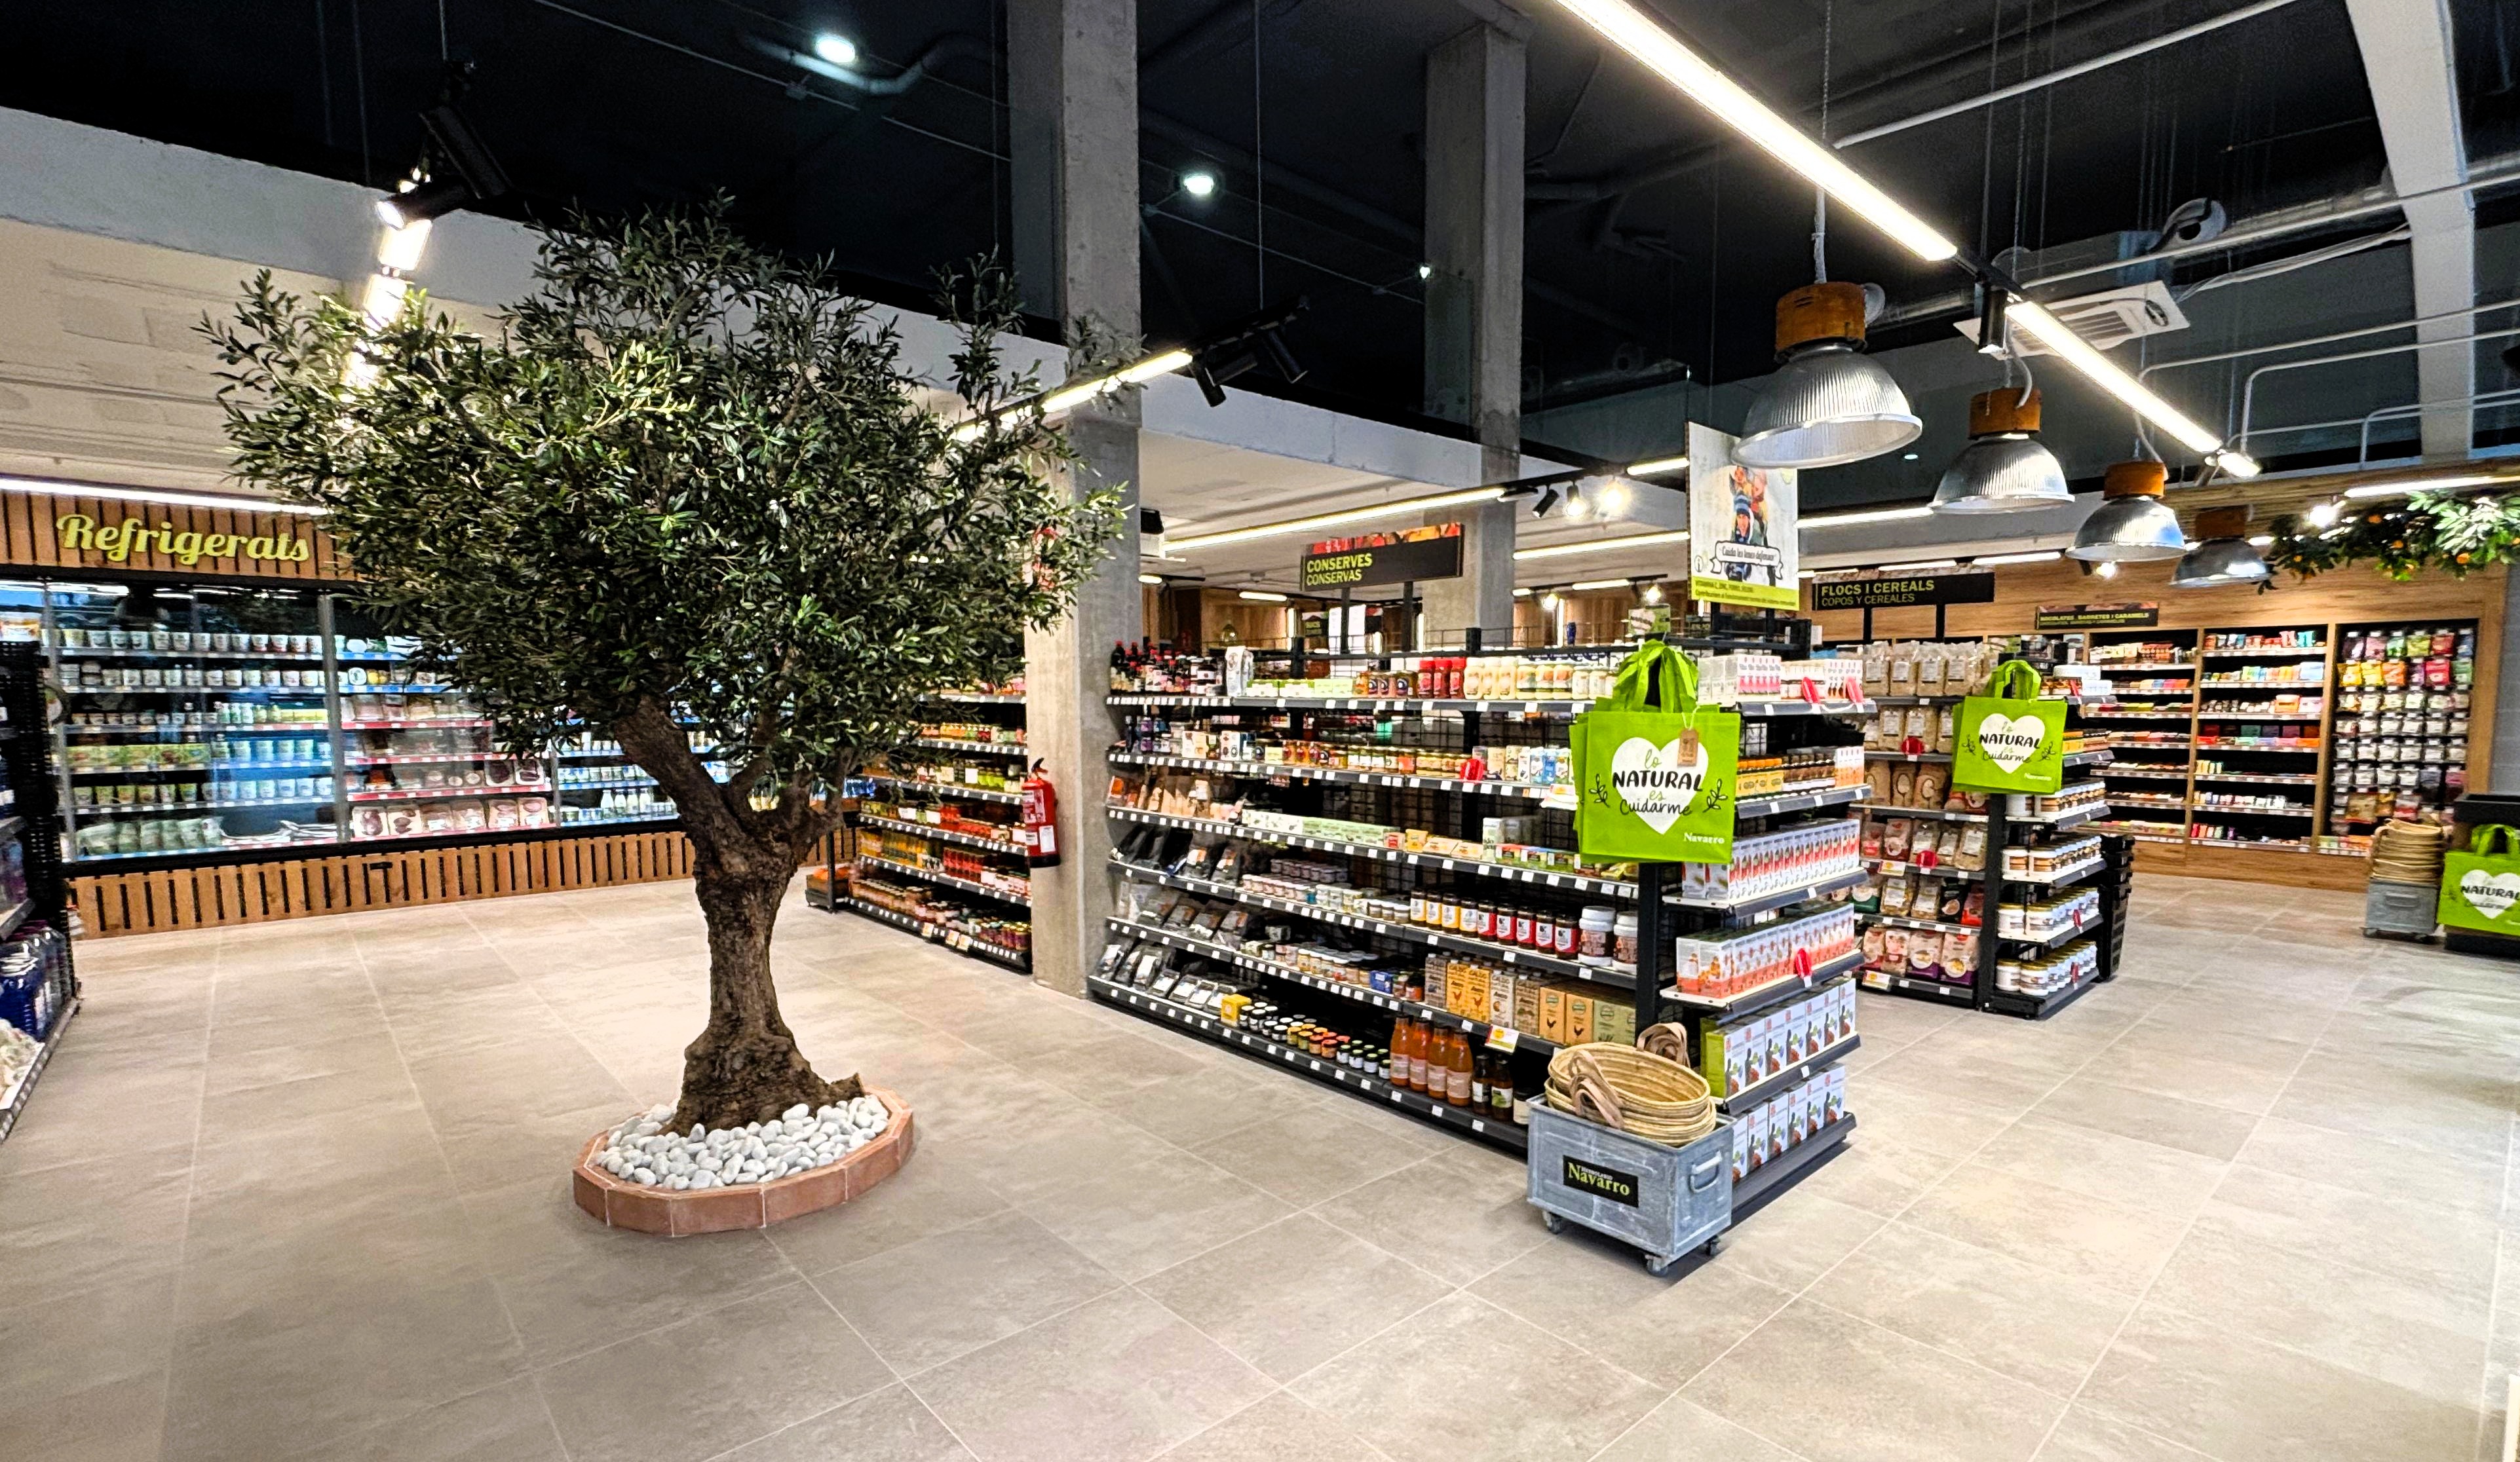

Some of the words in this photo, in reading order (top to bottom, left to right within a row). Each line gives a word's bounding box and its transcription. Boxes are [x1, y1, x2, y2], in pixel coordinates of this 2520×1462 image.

[57, 514, 309, 565] Refrigerats
[1307, 553, 1372, 573] CONSERVES
[1307, 569, 1362, 586] CONSERVAS
[1821, 583, 1861, 597] FLOCS
[1865, 584, 1869, 593] I
[1873, 580, 1934, 593] CEREALS
[1822, 596, 1854, 607] COPOS
[1856, 595, 1862, 605] Y
[1864, 593, 1915, 604] CEREALES
[1979, 733, 2040, 749] NATURAL
[1613, 770, 1704, 792] NATURAL
[1620, 798, 1692, 815] Cuidarme
[1683, 831, 1725, 844] Navarro
[1568, 1162, 1630, 1196] Navarro
